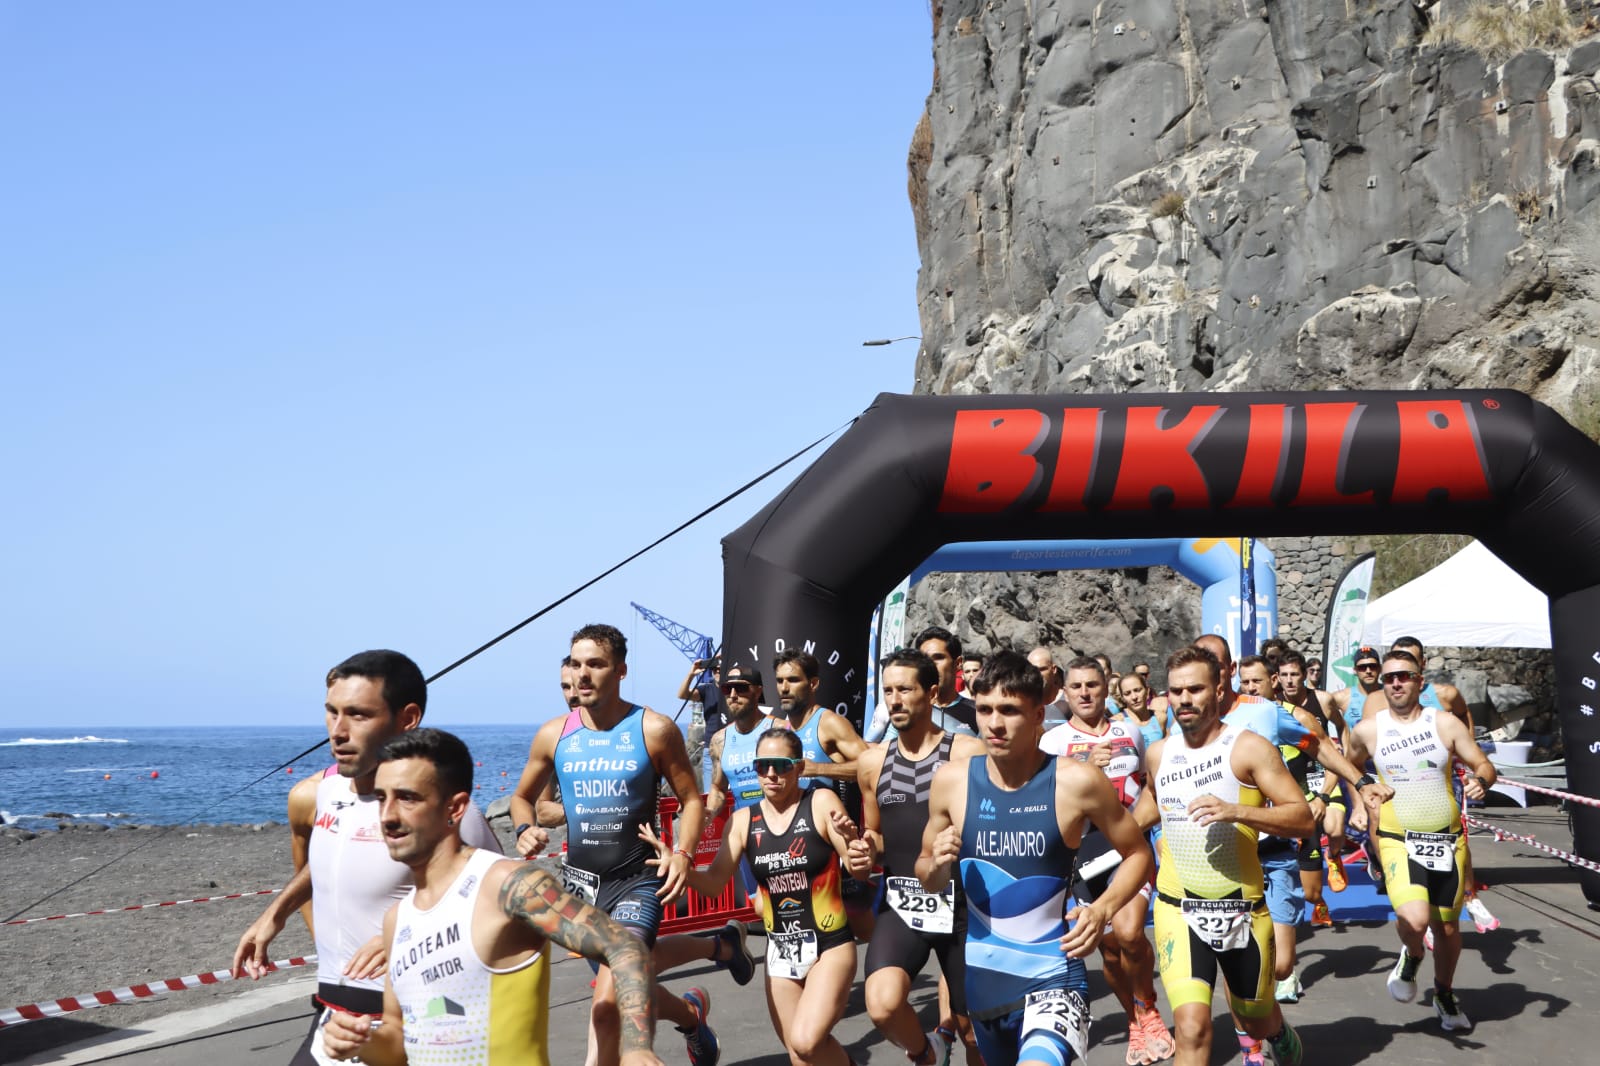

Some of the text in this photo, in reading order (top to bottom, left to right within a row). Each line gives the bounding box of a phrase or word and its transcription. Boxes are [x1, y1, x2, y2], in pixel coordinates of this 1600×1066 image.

[937, 400, 1496, 512] BIKILA
[1011, 547, 1131, 560] deportestenerife.com
[1381, 730, 1433, 756] CICLOTEAM
[1412, 743, 1437, 757] TRIATOR
[562, 757, 638, 773] anthus
[1160, 755, 1222, 787] CICLOTEAM
[1194, 770, 1223, 788] TRIATOR
[573, 779, 629, 798] ENDIKA
[1024, 804, 1048, 813] REALES
[976, 831, 1046, 856] ALEJANDRO
[1415, 844, 1445, 857] 225
[766, 872, 809, 894] AROSTEGUI
[897, 896, 938, 913] 229
[1197, 916, 1235, 934] 227
[420, 956, 465, 986] TRIATOR
[1036, 1001, 1081, 1032] 223
